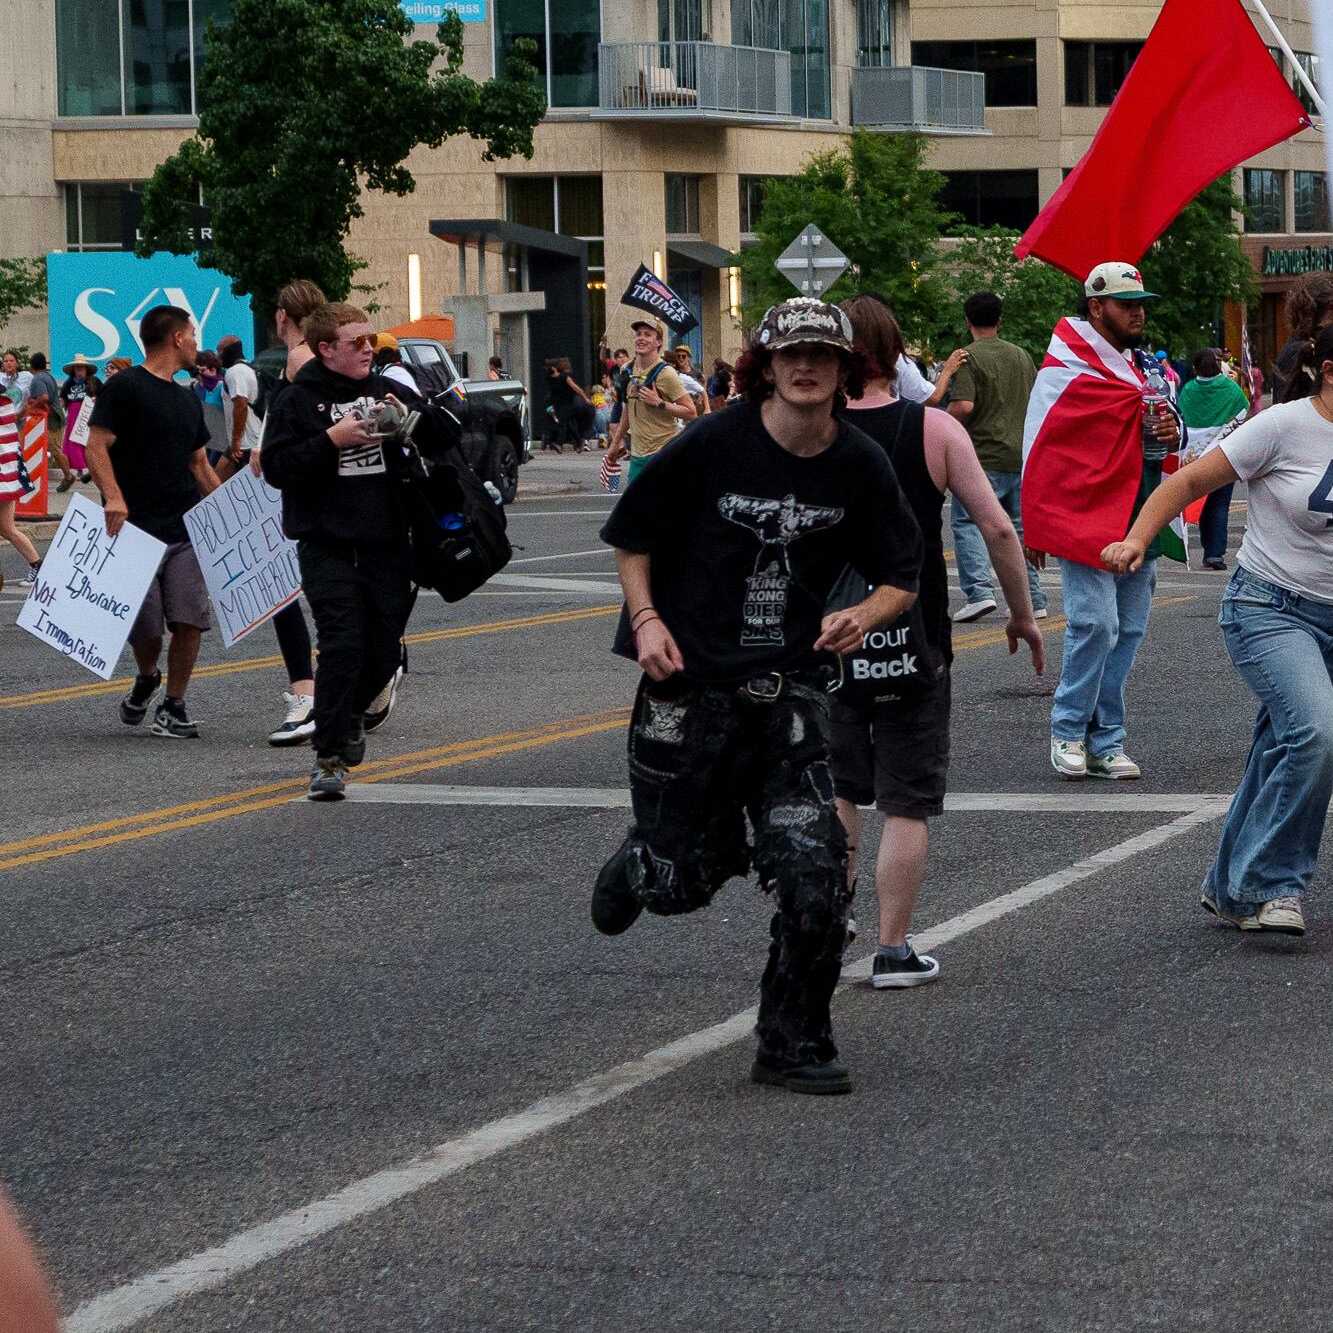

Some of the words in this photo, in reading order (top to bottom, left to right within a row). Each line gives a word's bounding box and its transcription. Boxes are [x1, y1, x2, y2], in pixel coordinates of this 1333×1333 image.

[631, 284, 683, 323] TRUMP
[188, 473, 264, 556] ABOLISH
[56, 508, 120, 576] Fight
[212, 530, 263, 590] ICE
[65, 565, 131, 620] Ignorance
[747, 590, 785, 602] KONG
[750, 577, 788, 590] KING
[744, 603, 785, 617] DIED
[852, 652, 919, 680] Back
